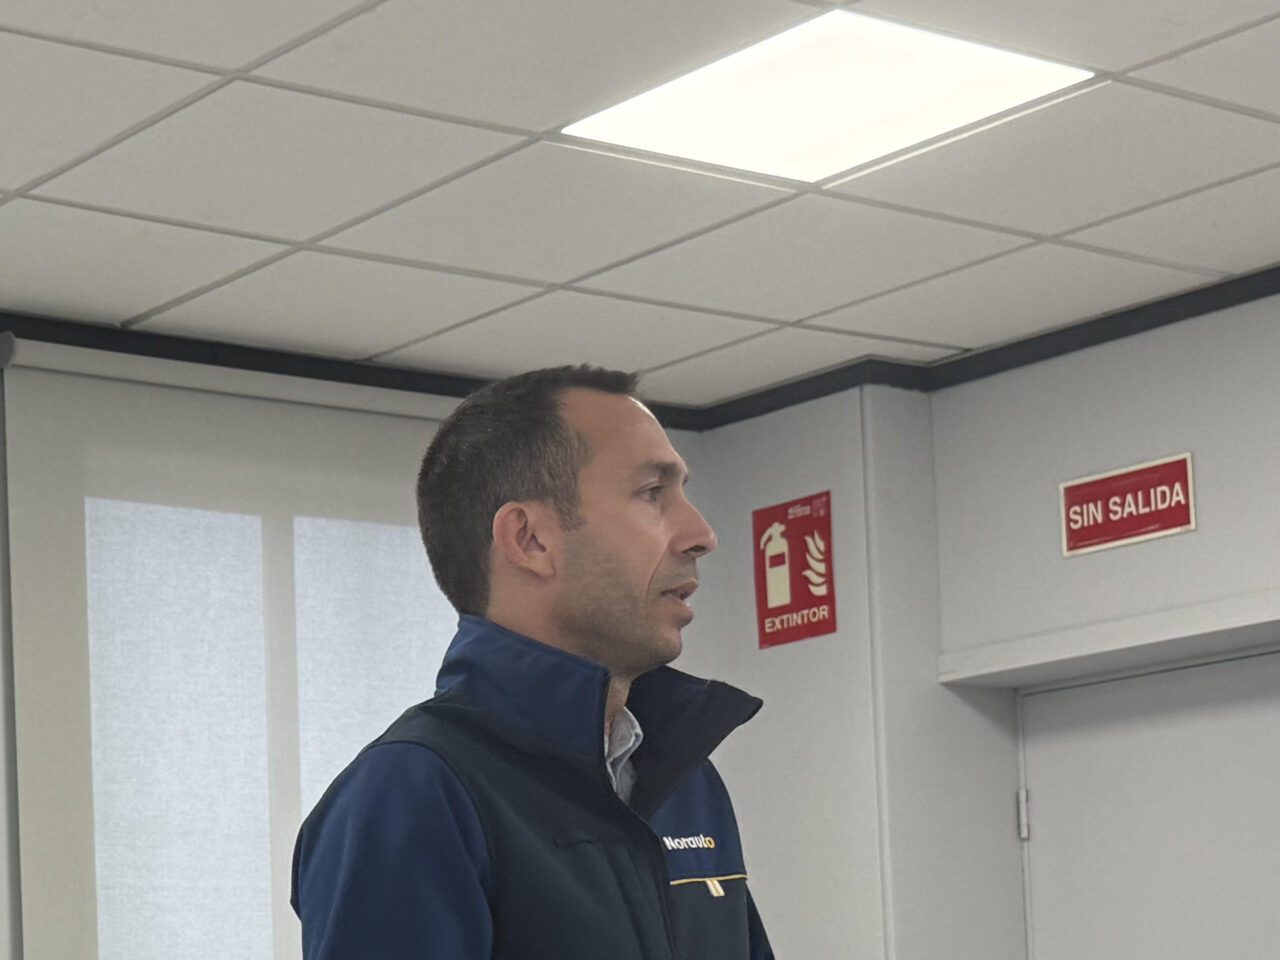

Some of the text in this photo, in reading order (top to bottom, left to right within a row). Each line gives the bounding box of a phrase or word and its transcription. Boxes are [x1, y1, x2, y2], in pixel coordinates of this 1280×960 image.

[1069, 481, 1186, 530] SIN SALIDA
[765, 605, 829, 633] EXTINTOR
[663, 834, 716, 850] Norauto
